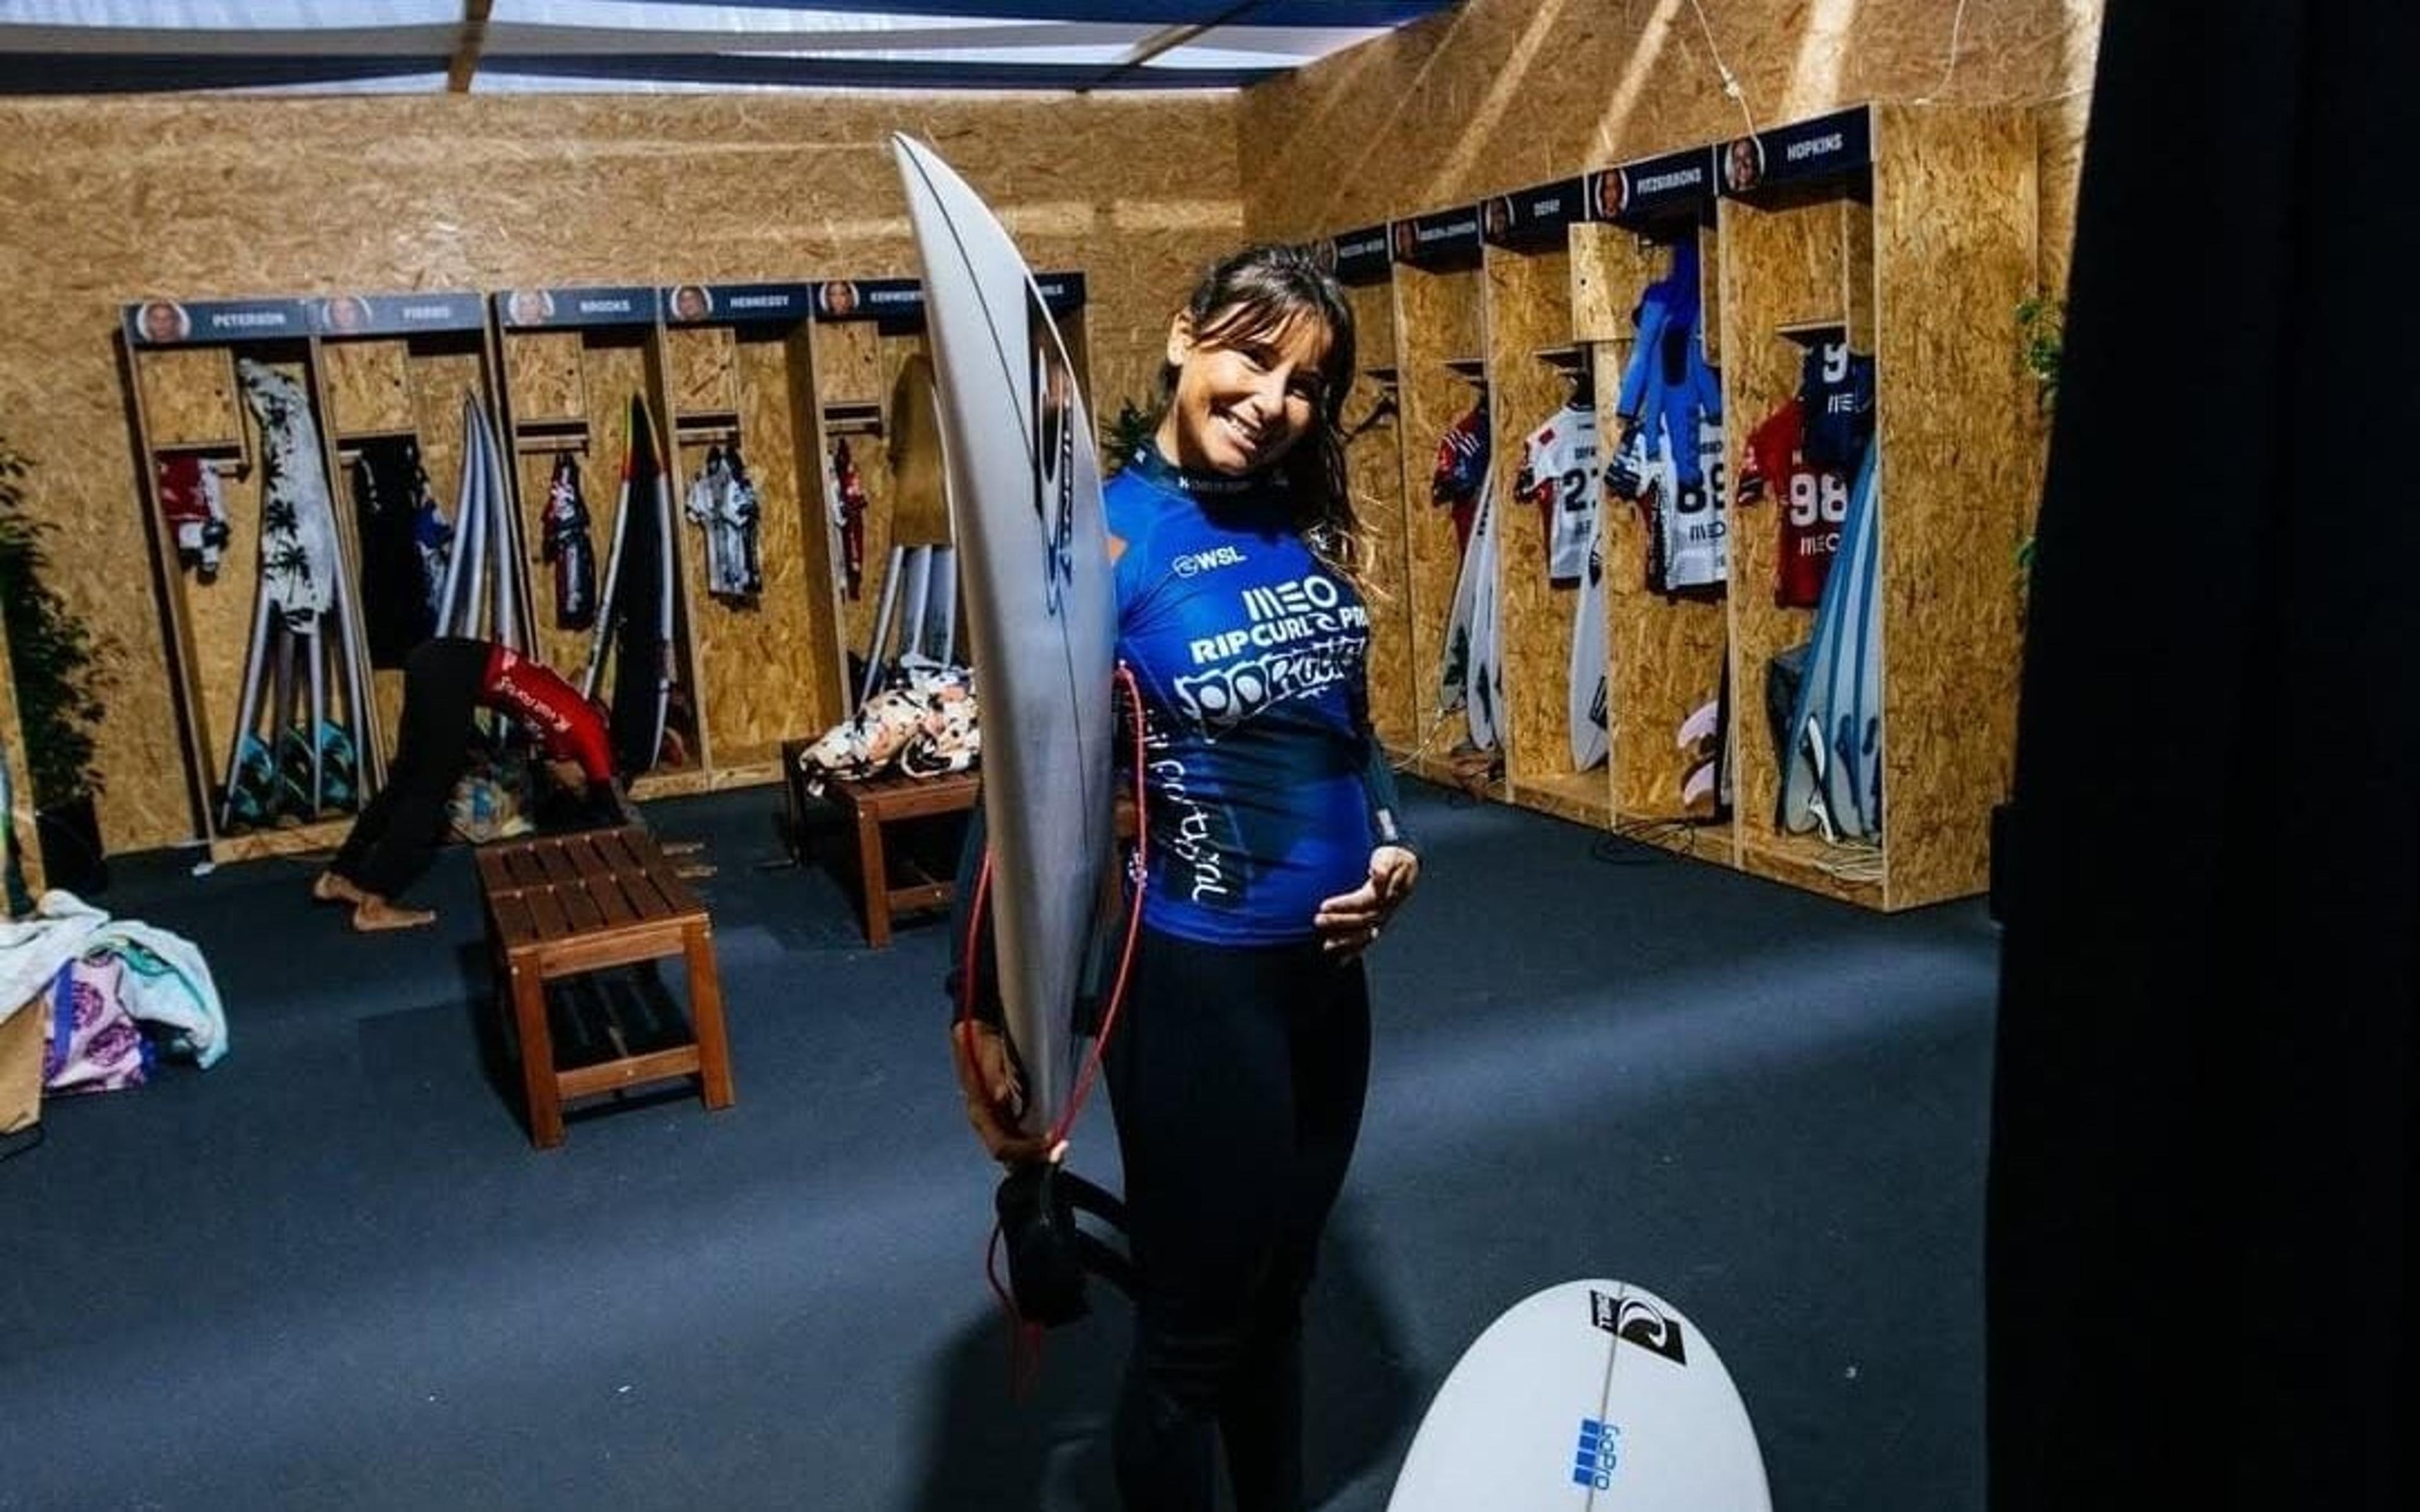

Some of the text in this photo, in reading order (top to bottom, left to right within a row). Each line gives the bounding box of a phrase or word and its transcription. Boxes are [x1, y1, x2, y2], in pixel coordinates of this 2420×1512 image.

[1787, 134, 1843, 163] HOPKINS
[212, 311, 286, 328] PETERSON
[729, 295, 789, 308] HENNESSY
[1790, 474, 1848, 526] 98
[1194, 546, 1247, 571] WSL
[1241, 575, 1338, 621] MEO
[1190, 630, 1249, 665] RIP
[1250, 616, 1315, 647] CURL
[1594, 1424, 1620, 1491] GoPro
